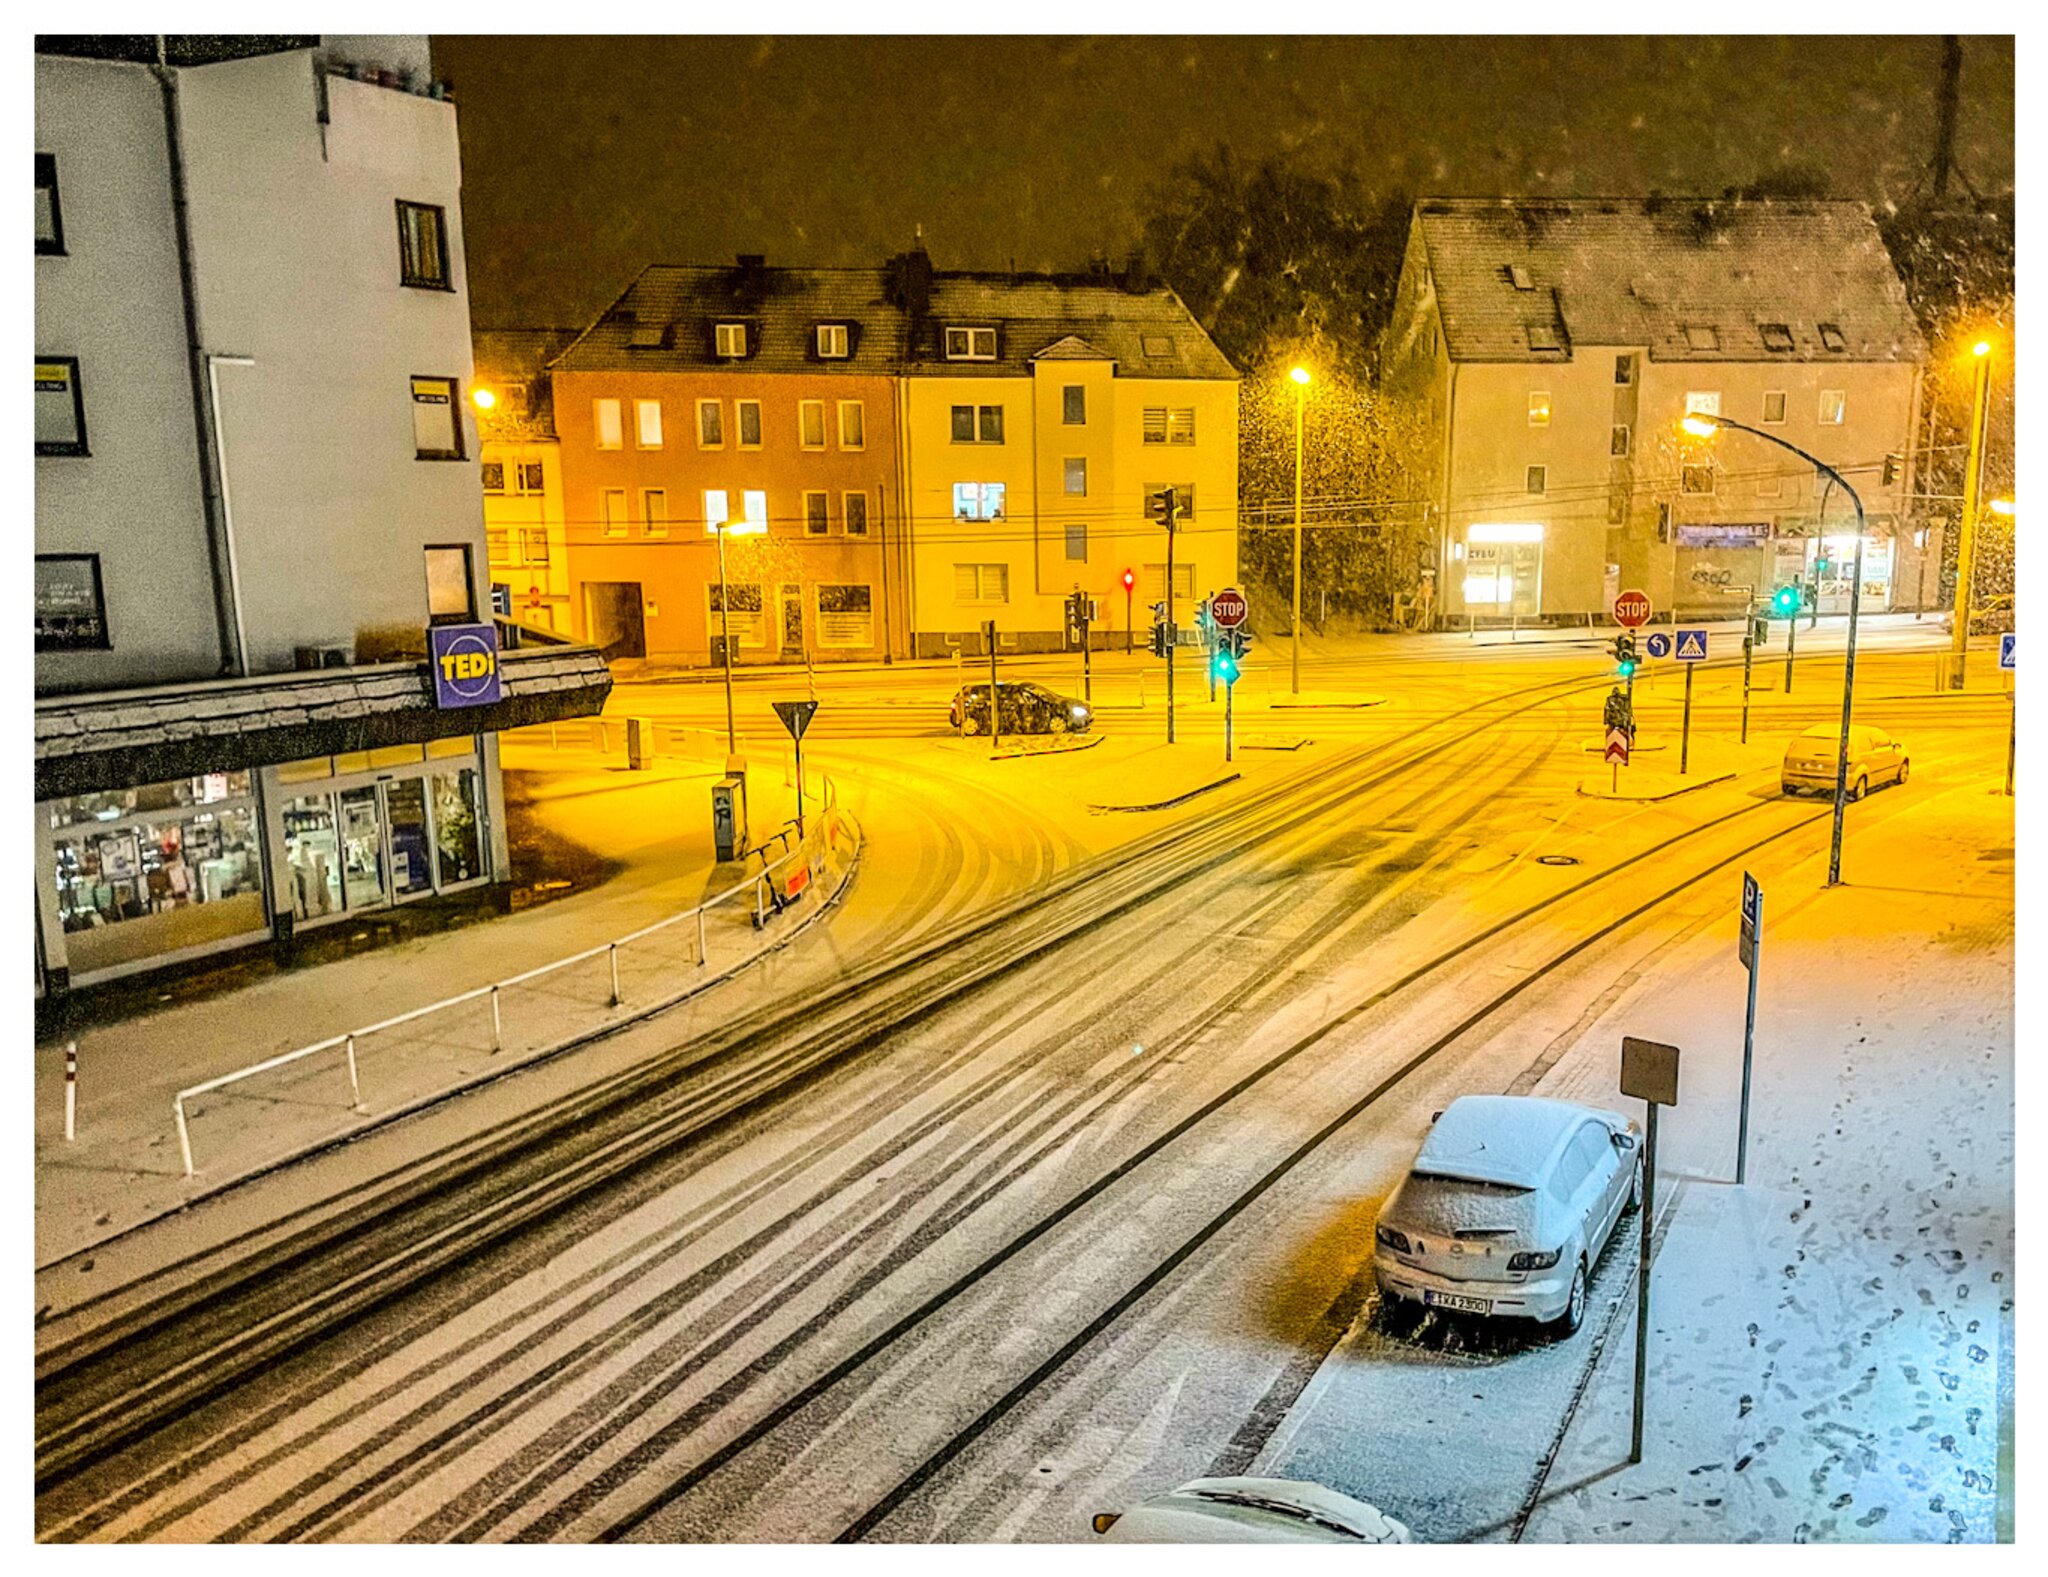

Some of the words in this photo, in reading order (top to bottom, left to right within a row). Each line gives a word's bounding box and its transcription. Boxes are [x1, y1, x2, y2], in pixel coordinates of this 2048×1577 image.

[1213, 602, 1244, 617] STOP
[1617, 602, 1648, 617] STOP
[440, 651, 495, 681] TEDi
[1744, 879, 1755, 911] P
